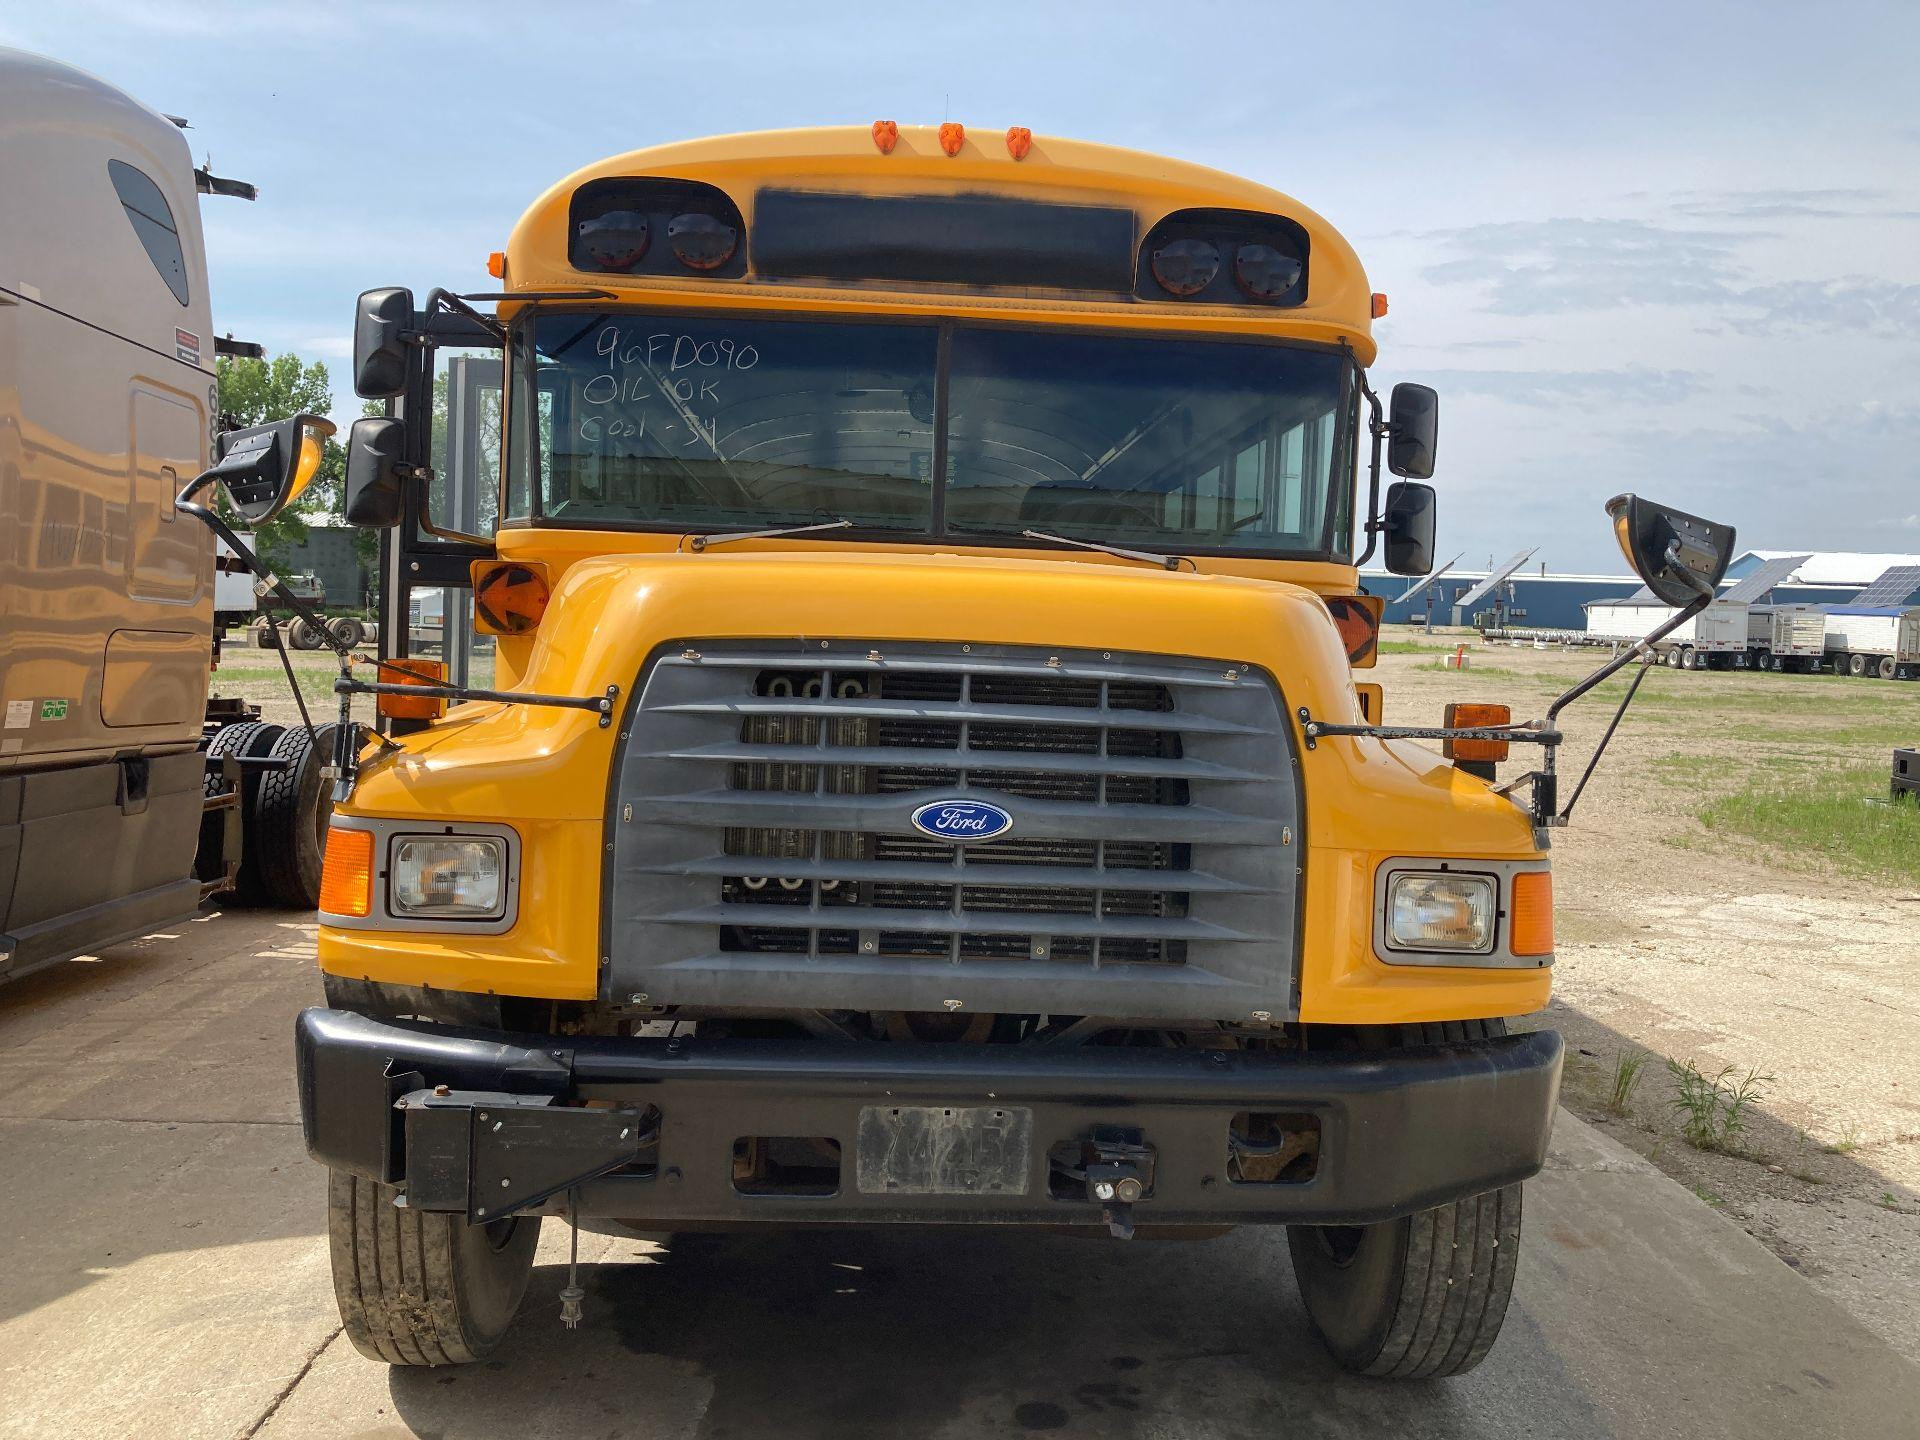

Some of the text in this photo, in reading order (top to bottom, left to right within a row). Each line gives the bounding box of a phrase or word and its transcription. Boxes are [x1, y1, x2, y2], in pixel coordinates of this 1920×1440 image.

[596, 326, 759, 372] 96FD090
[583, 374, 720, 404] OIL OK
[935, 807, 988, 830] Ford
